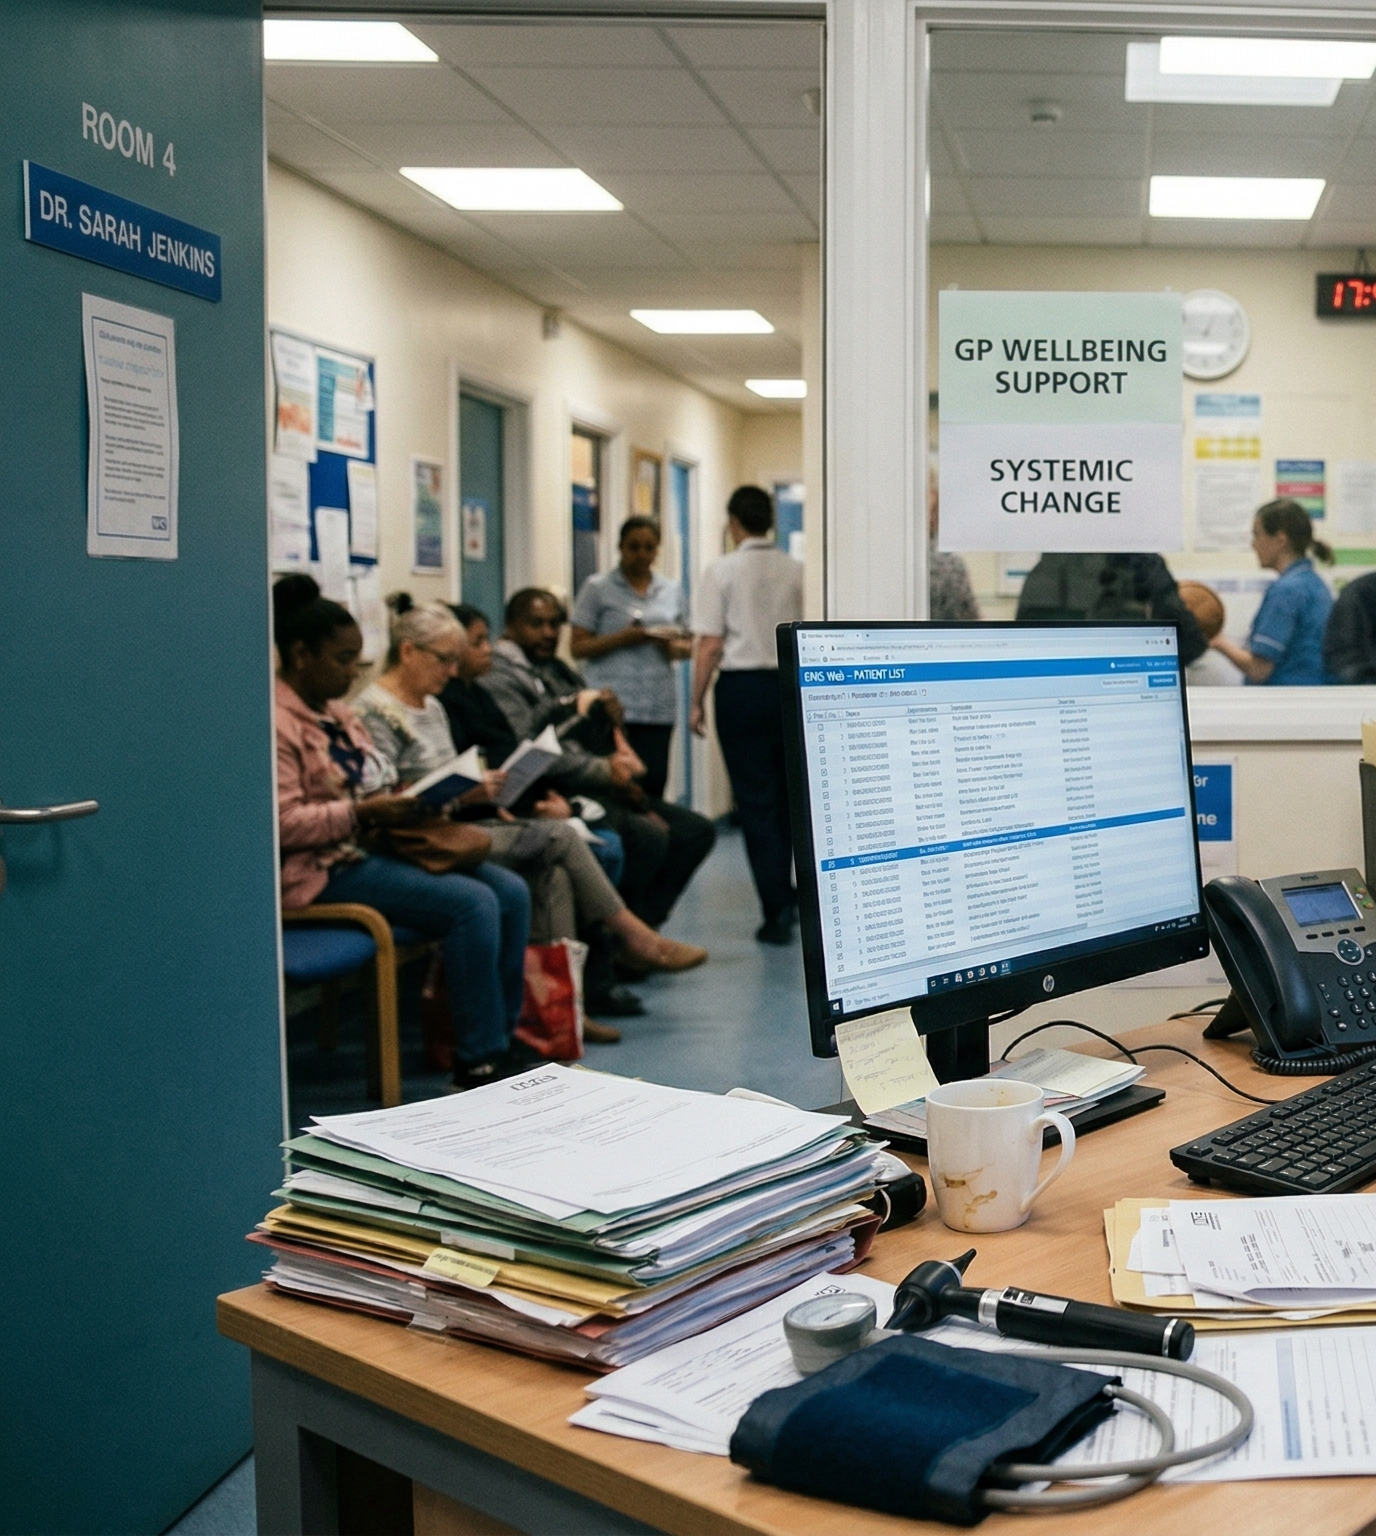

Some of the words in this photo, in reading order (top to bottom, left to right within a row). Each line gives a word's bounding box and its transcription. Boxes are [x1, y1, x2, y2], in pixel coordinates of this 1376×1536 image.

[82, 102, 154, 168] ROOM
[162, 143, 177, 177] 4
[39, 189, 73, 230] DR.
[78, 203, 141, 253] SARAH
[147, 231, 215, 278] JENKINS
[955, 338, 994, 363] GP
[1002, 338, 1168, 363] WELLBEING
[995, 370, 1129, 395] SUPPORT
[989, 458, 1134, 483] SYSTEMIC
[1000, 490, 1122, 515] CHANGE
[853, 668, 888, 680] PATIENT
[888, 668, 906, 679] LIST
